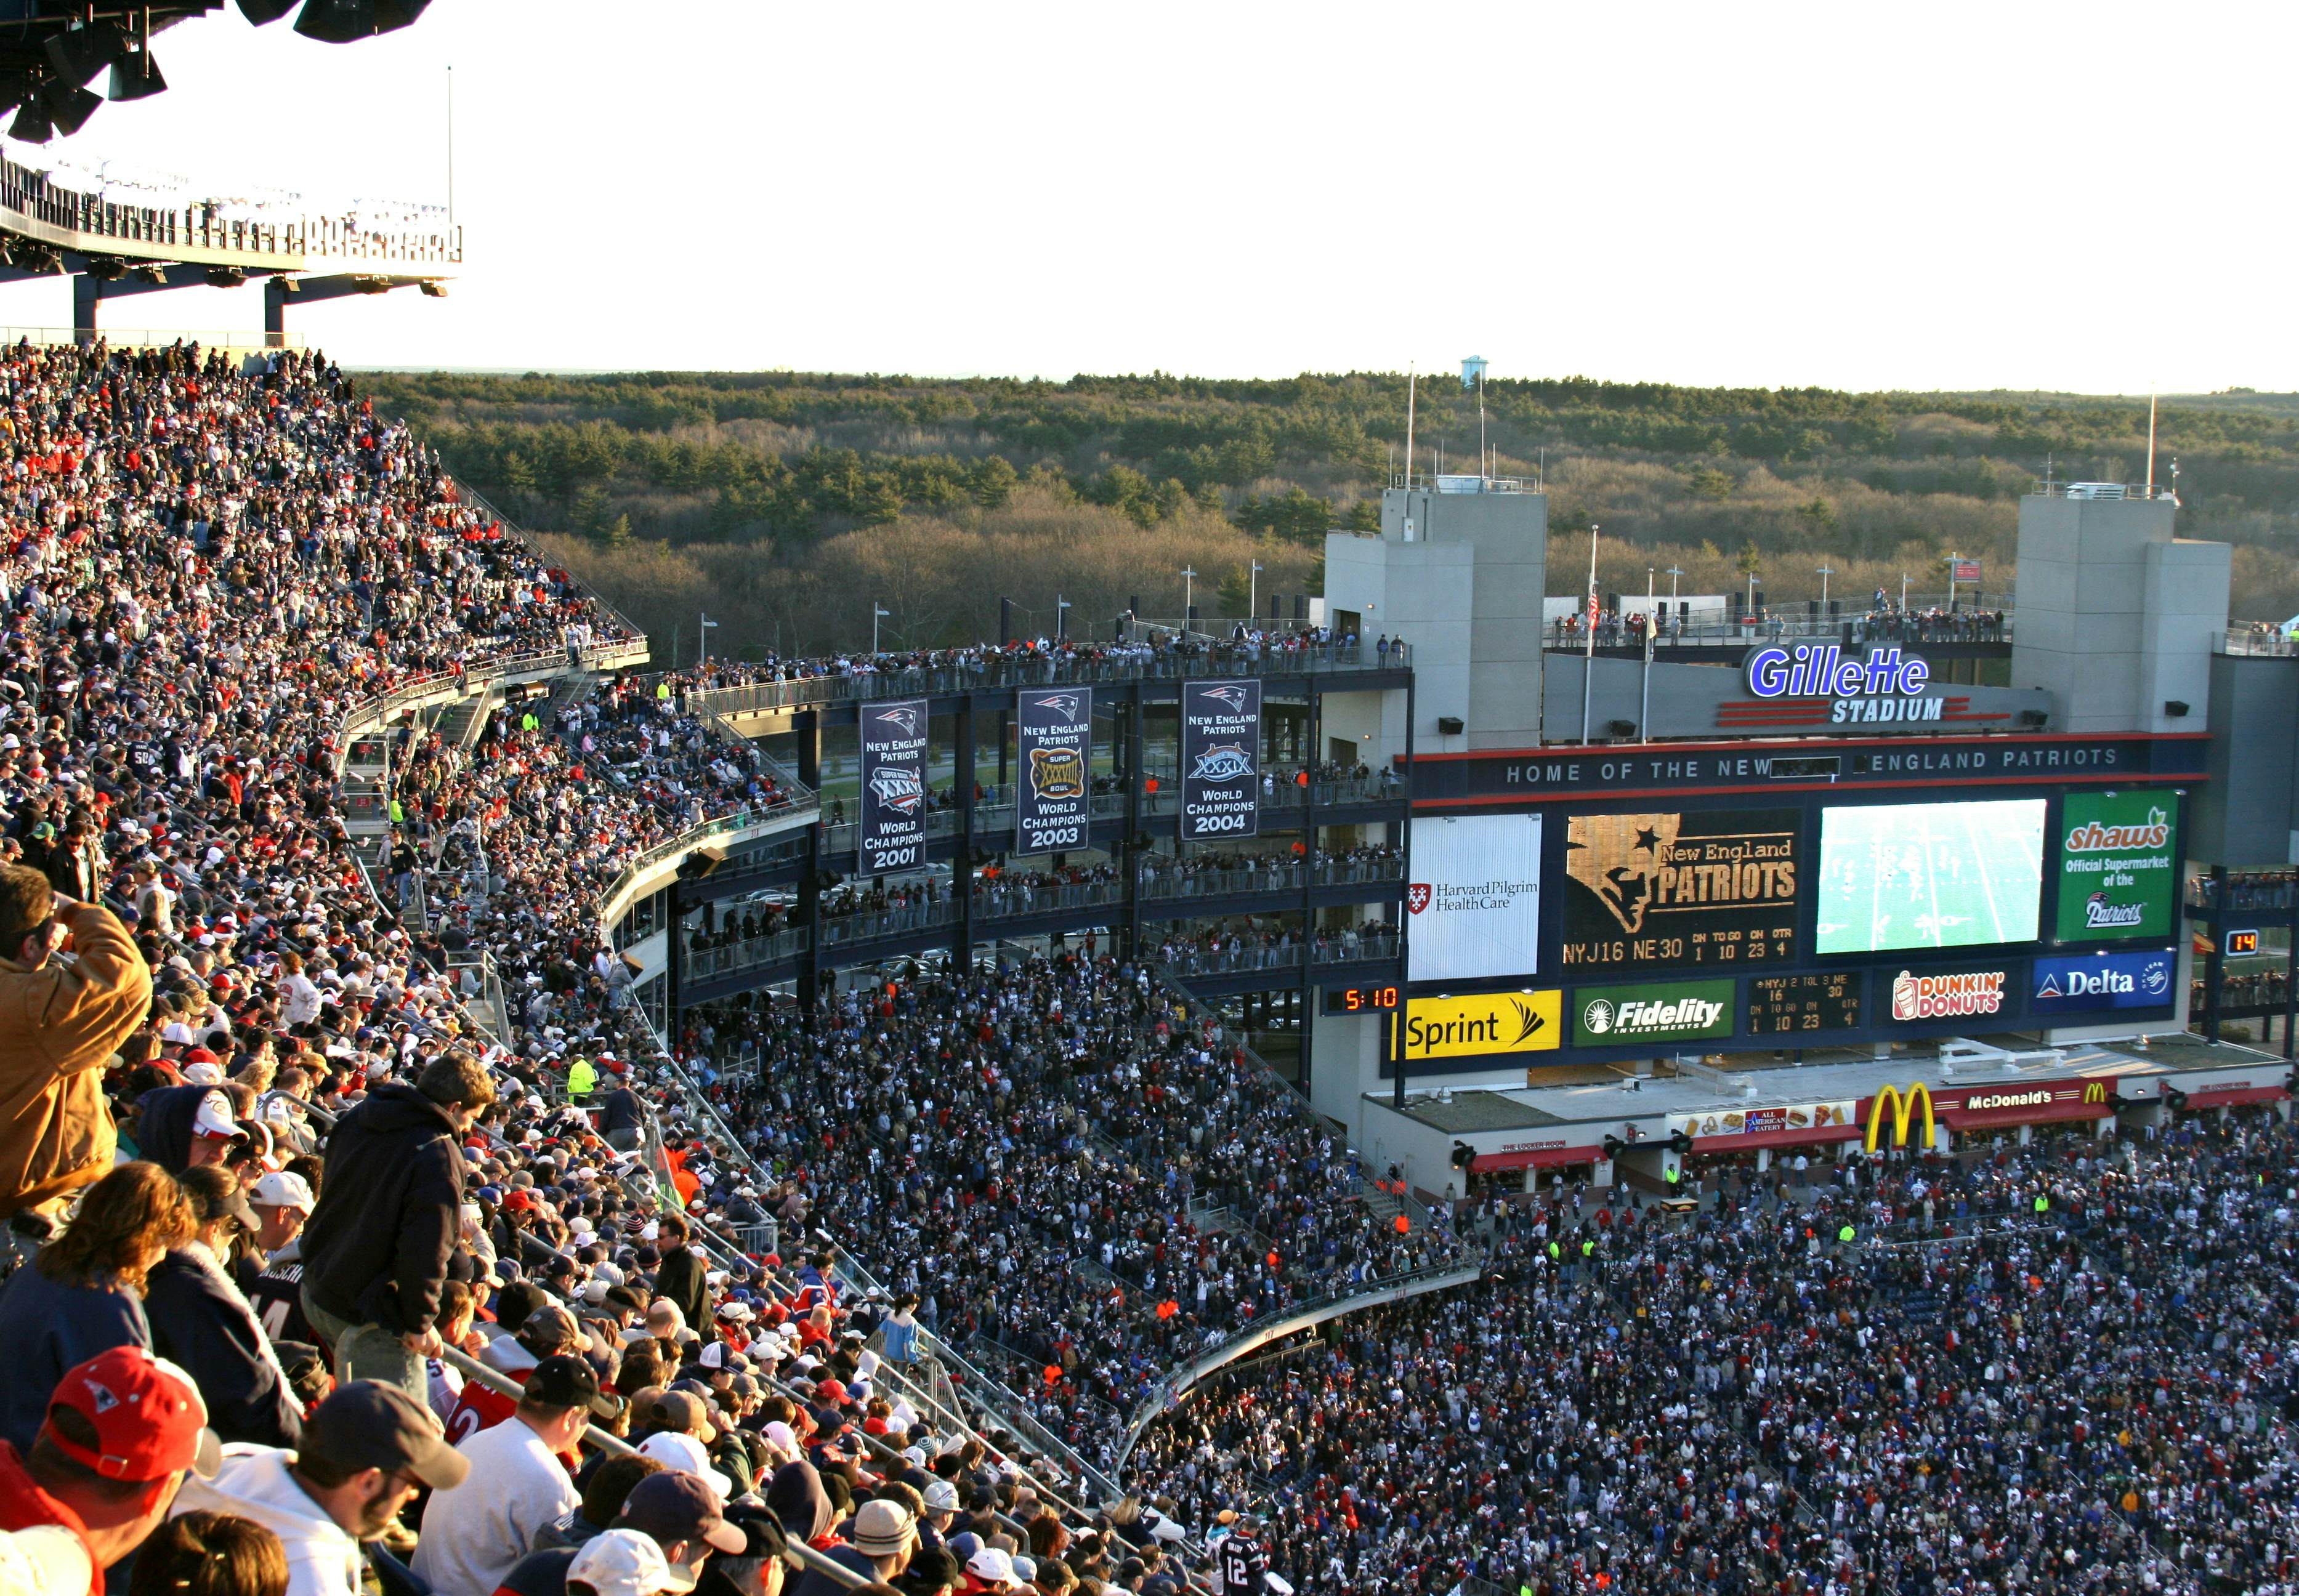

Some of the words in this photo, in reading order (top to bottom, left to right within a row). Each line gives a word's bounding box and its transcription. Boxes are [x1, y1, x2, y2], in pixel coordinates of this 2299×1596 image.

[1749, 645, 1929, 698] Gillette
[1832, 698, 1943, 723] STADIUM
[1189, 716, 1213, 725] NEW
[1216, 714, 1256, 724] ENGLAND
[1024, 727, 1047, 736] NEW
[1051, 723, 1088, 735] ENGLAND
[1203, 725, 1245, 735] PATRIOTS
[867, 742, 889, 752] NEW
[892, 738, 926, 750] ENGLAND
[1038, 735, 1078, 746] PATRIOTS
[881, 751, 918, 762] PATRIOTS
[1049, 755, 1070, 763] SUPER
[1194, 757, 1250, 776] XXXIX
[1507, 765, 1580, 783] HOME
[1601, 763, 1632, 780] OF
[1651, 761, 1698, 778] THE
[1718, 759, 1771, 776] NEW
[1872, 752, 1986, 771] ENGLAND
[2003, 749, 2116, 767] PATRIOTS
[881, 771, 897, 779] SUPER
[1202, 790, 1243, 800] WORLD
[1038, 803, 1077, 815] WORLD
[1187, 801, 1255, 815] CHAMPIONS
[879, 821, 916, 834] WORLD
[1022, 814, 1086, 829] CHAMPIONS
[1195, 815, 1245, 832] 2004
[865, 832, 923, 850] CHAMPIONS
[1031, 827, 1078, 847] 2003
[874, 847, 916, 868] 2001
[1662, 845, 1700, 861] New
[1705, 840, 1791, 863] England
[2066, 858, 2102, 872] Official
[2104, 856, 2169, 873] Supermarket
[1658, 861, 1795, 903] PATRIOTS
[2103, 874, 2114, 887] of
[2117, 874, 2133, 885] the
[1436, 882, 1489, 897] Harvard
[1492, 881, 1538, 897] Pilgrim
[1436, 897, 1478, 911] Health
[1481, 897, 1509, 909] Care
[2086, 901, 2141, 927] Patriots
[1695, 947, 1702, 961] 1
[1719, 945, 1734, 960] 10
[1748, 943, 1765, 958] 23
[1777, 941, 1785, 956] 4
[2237, 935, 2255, 951] 14
[1765, 978, 1786, 989] NYJ
[1833, 975, 1848, 984] NE
[1919, 972, 2004, 997] DUNKIN'
[2066, 971, 2134, 996] Delta
[1346, 987, 1396, 1010] 5:10
[1769, 989, 1784, 1001] 16
[1615, 998, 1724, 1028] Fidelity
[1918, 994, 1998, 1018] DONUTS
[1614, 1023, 1700, 1034] INVESTMENTS
[1776, 1016, 1790, 1031] 10
[1803, 1014, 1820, 1029] 23
[1844, 1012, 1853, 1025] 4
[1407, 1012, 1498, 1054] Sprint
[1968, 1090, 2051, 1110] McDonald's
[1752, 1118, 1786, 1126] AMERICAN
[1246, 1541, 1259, 1552] 12
[1227, 1556, 1248, 1586] 12
